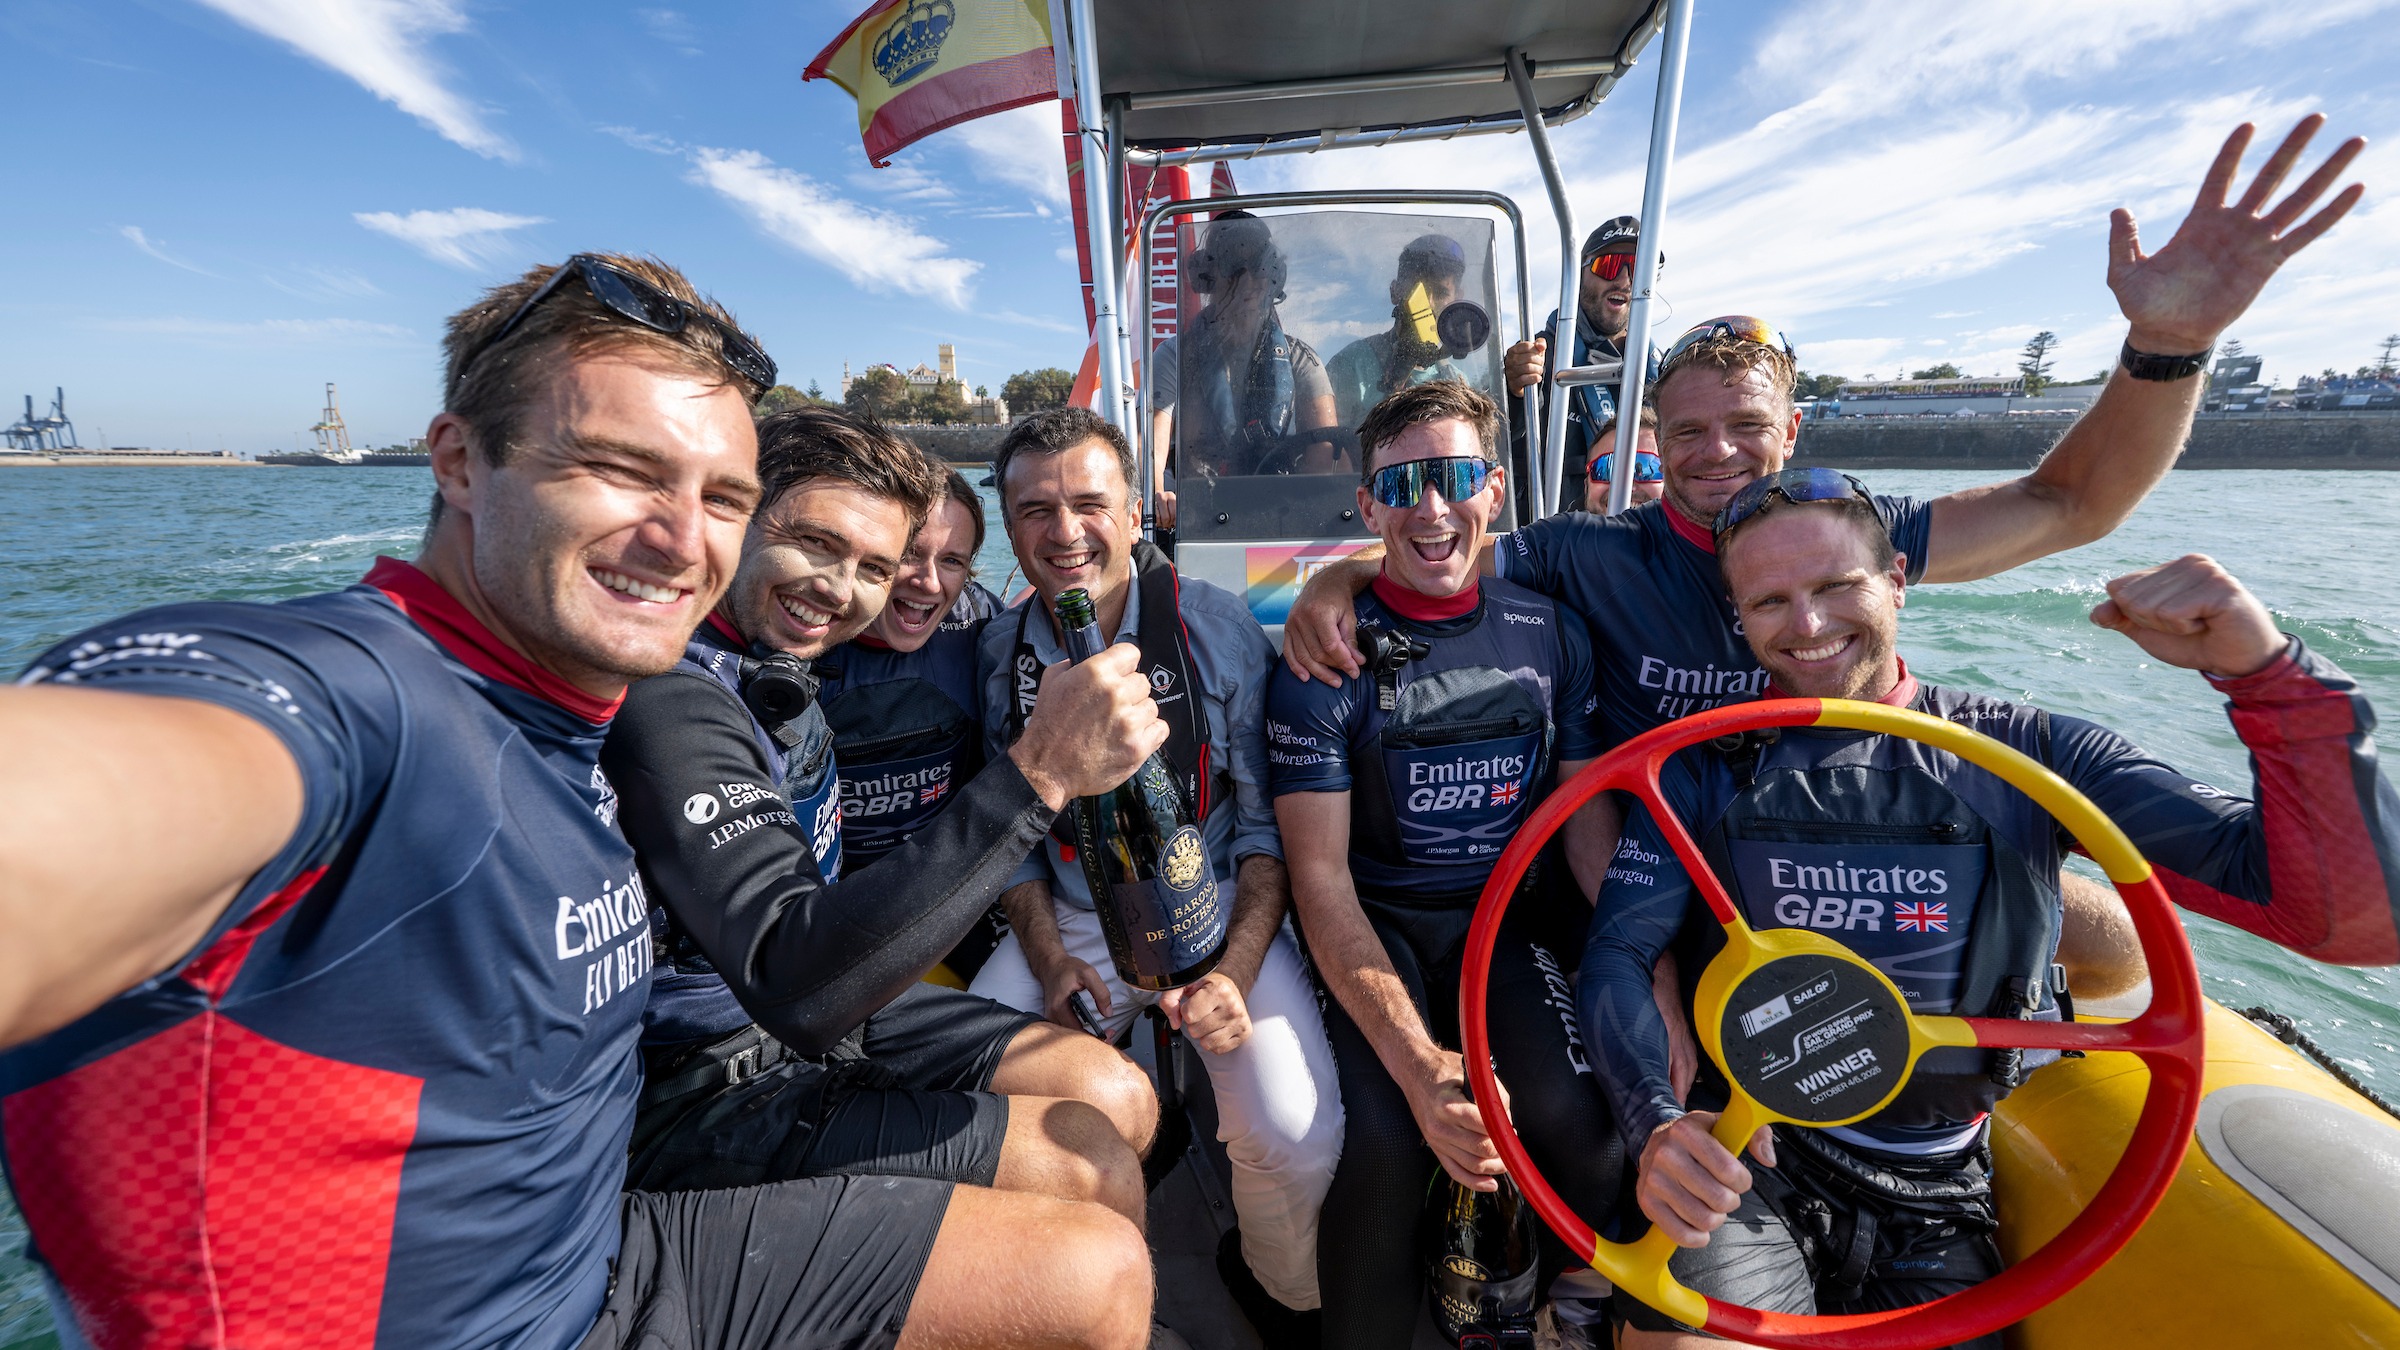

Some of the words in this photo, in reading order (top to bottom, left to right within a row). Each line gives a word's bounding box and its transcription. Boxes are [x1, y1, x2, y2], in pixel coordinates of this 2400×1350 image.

[1602, 227, 1640, 240] SAIL
[1153, 300, 1177, 338] FLY
[1657, 694, 1694, 719] FLY
[1272, 720, 1291, 734] low
[1275, 733, 1317, 747] carbon
[839, 761, 952, 797] Emirates
[1409, 754, 1524, 785] Emirates
[719, 782, 756, 798] low
[1407, 784, 1485, 813] GBR
[841, 791, 914, 817] GBR
[708, 810, 798, 850] J.P.Morga
[1479, 846, 1501, 854] carbon
[1619, 848, 1660, 864] carbon
[1768, 858, 1949, 894] Emirates
[1173, 880, 1215, 920] BARONS
[1774, 894, 1885, 932] GBR
[1146, 928, 1168, 943] DE
[1201, 936, 1219, 954] BRUT
[583, 953, 613, 1015] FLY
[1530, 942, 1593, 1076] Emirates
[1760, 1010, 1785, 1026] ROLEX
[1803, 1035, 1824, 1050] SAIL
[1823, 1019, 1854, 1041] GRAND
[1854, 1008, 1875, 1025] PRIX
[1811, 1022, 1833, 1038] WORLD
[1833, 1014, 1851, 1029] SPAIN
[1760, 1064, 1770, 1073] DP
[1769, 1055, 1790, 1070] WORLD
[1794, 1047, 1877, 1095] WINNER
[1810, 1080, 1850, 1105] OCTOBER
[1861, 1066, 1882, 1081] 2025
[1892, 1259, 1946, 1272] spinlock
